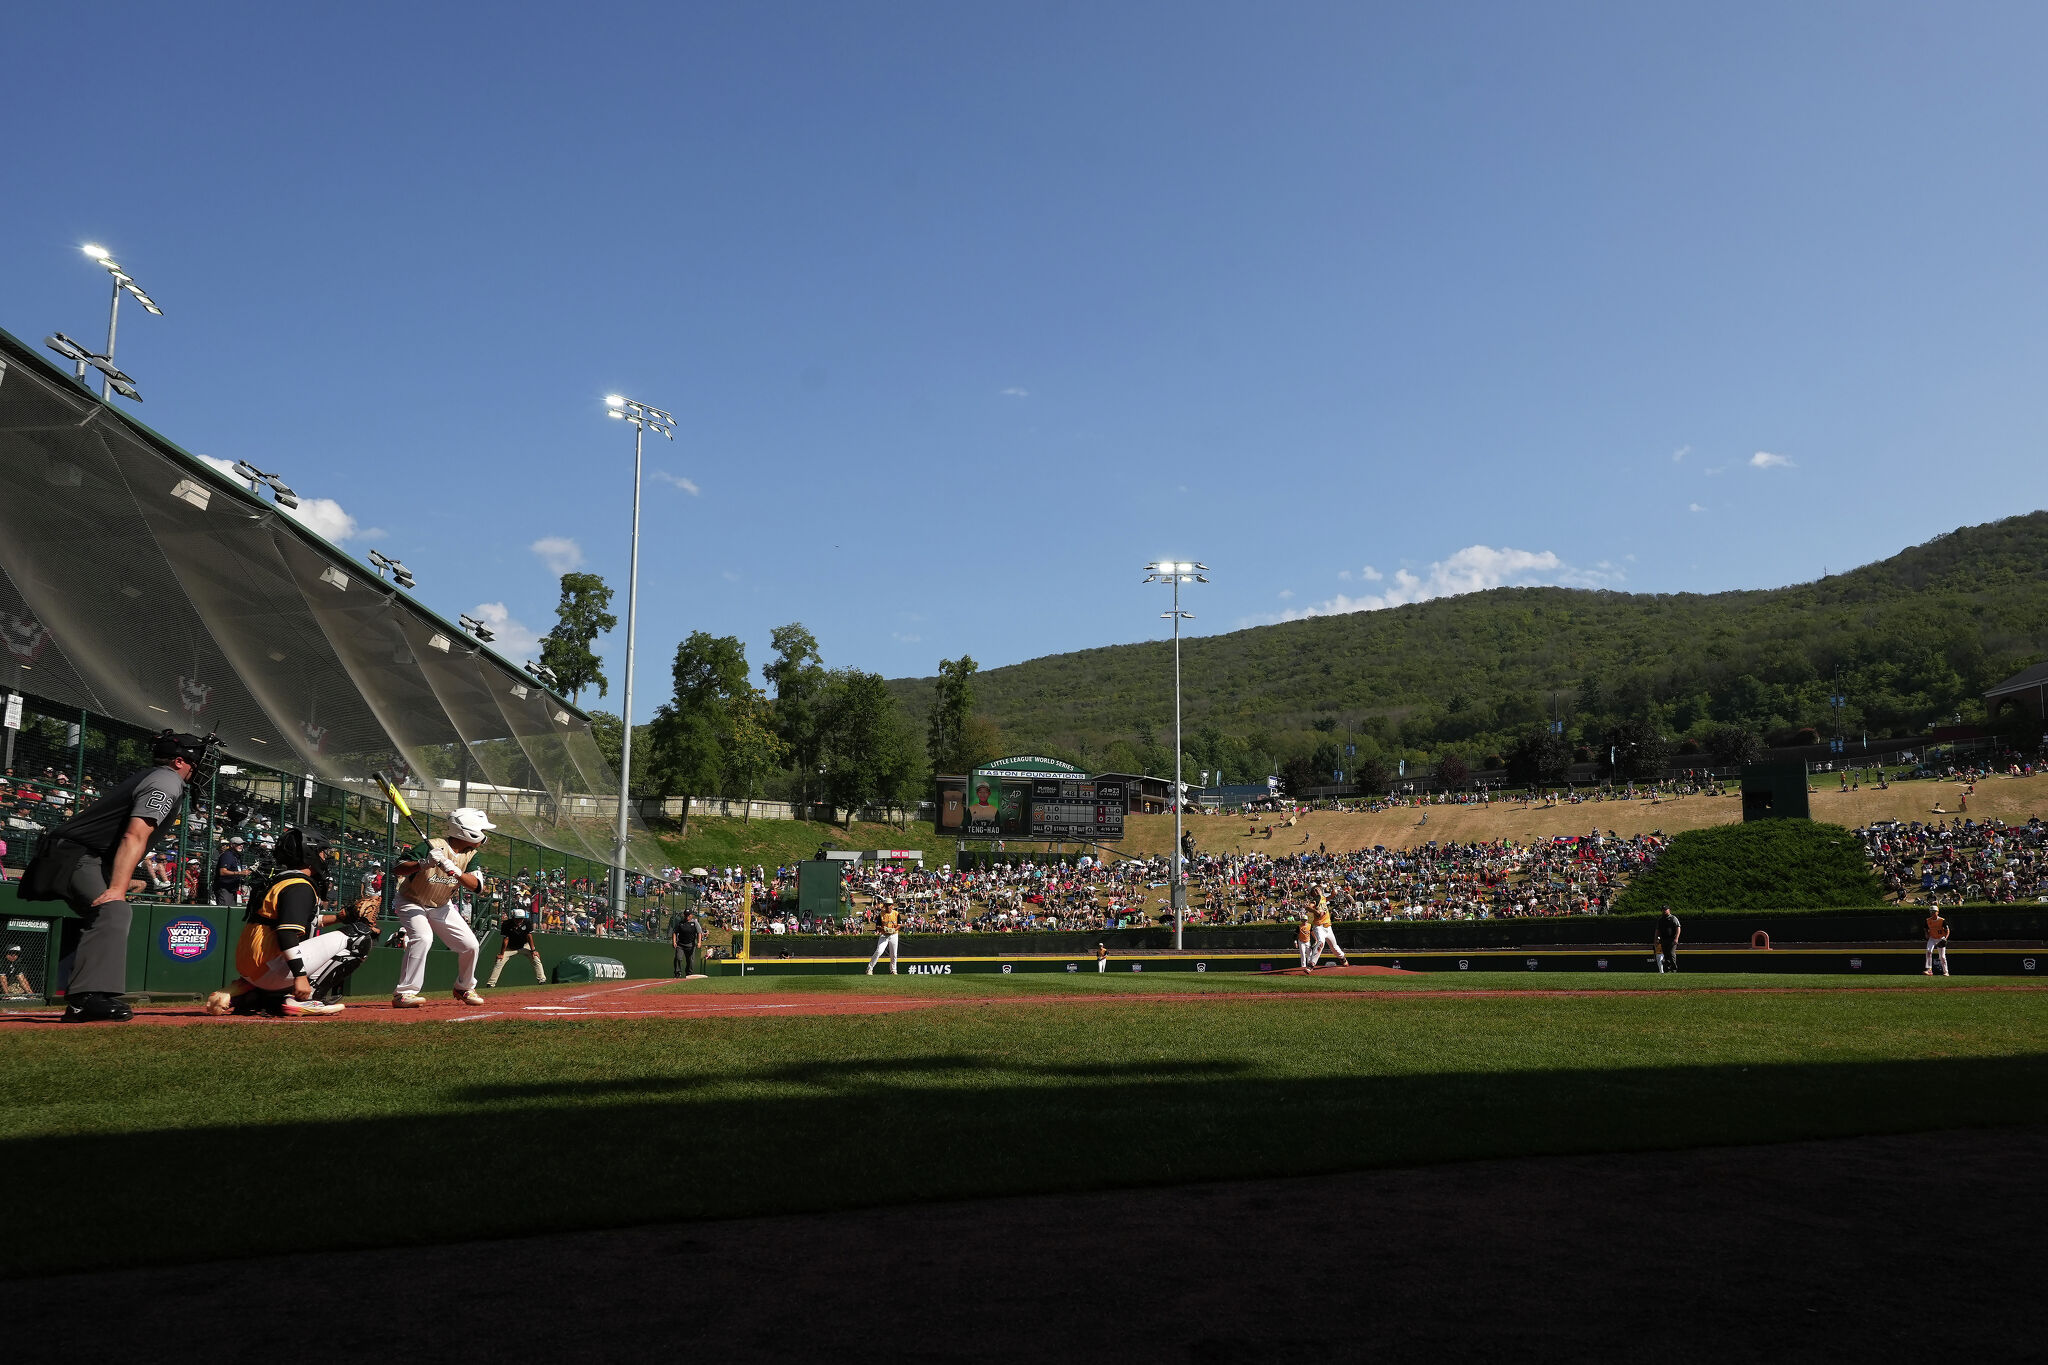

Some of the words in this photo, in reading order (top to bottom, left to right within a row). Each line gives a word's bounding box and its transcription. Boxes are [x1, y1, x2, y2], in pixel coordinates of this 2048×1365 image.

[990, 759, 1009, 768] LITTLE
[1034, 756, 1055, 765] WORLD
[1055, 760, 1074, 771] SERIES
[949, 800, 958, 811] 17
[169, 928, 209, 936] WORLD
[170, 935, 207, 943] SERIES
[907, 964, 952, 975] #LLWS
